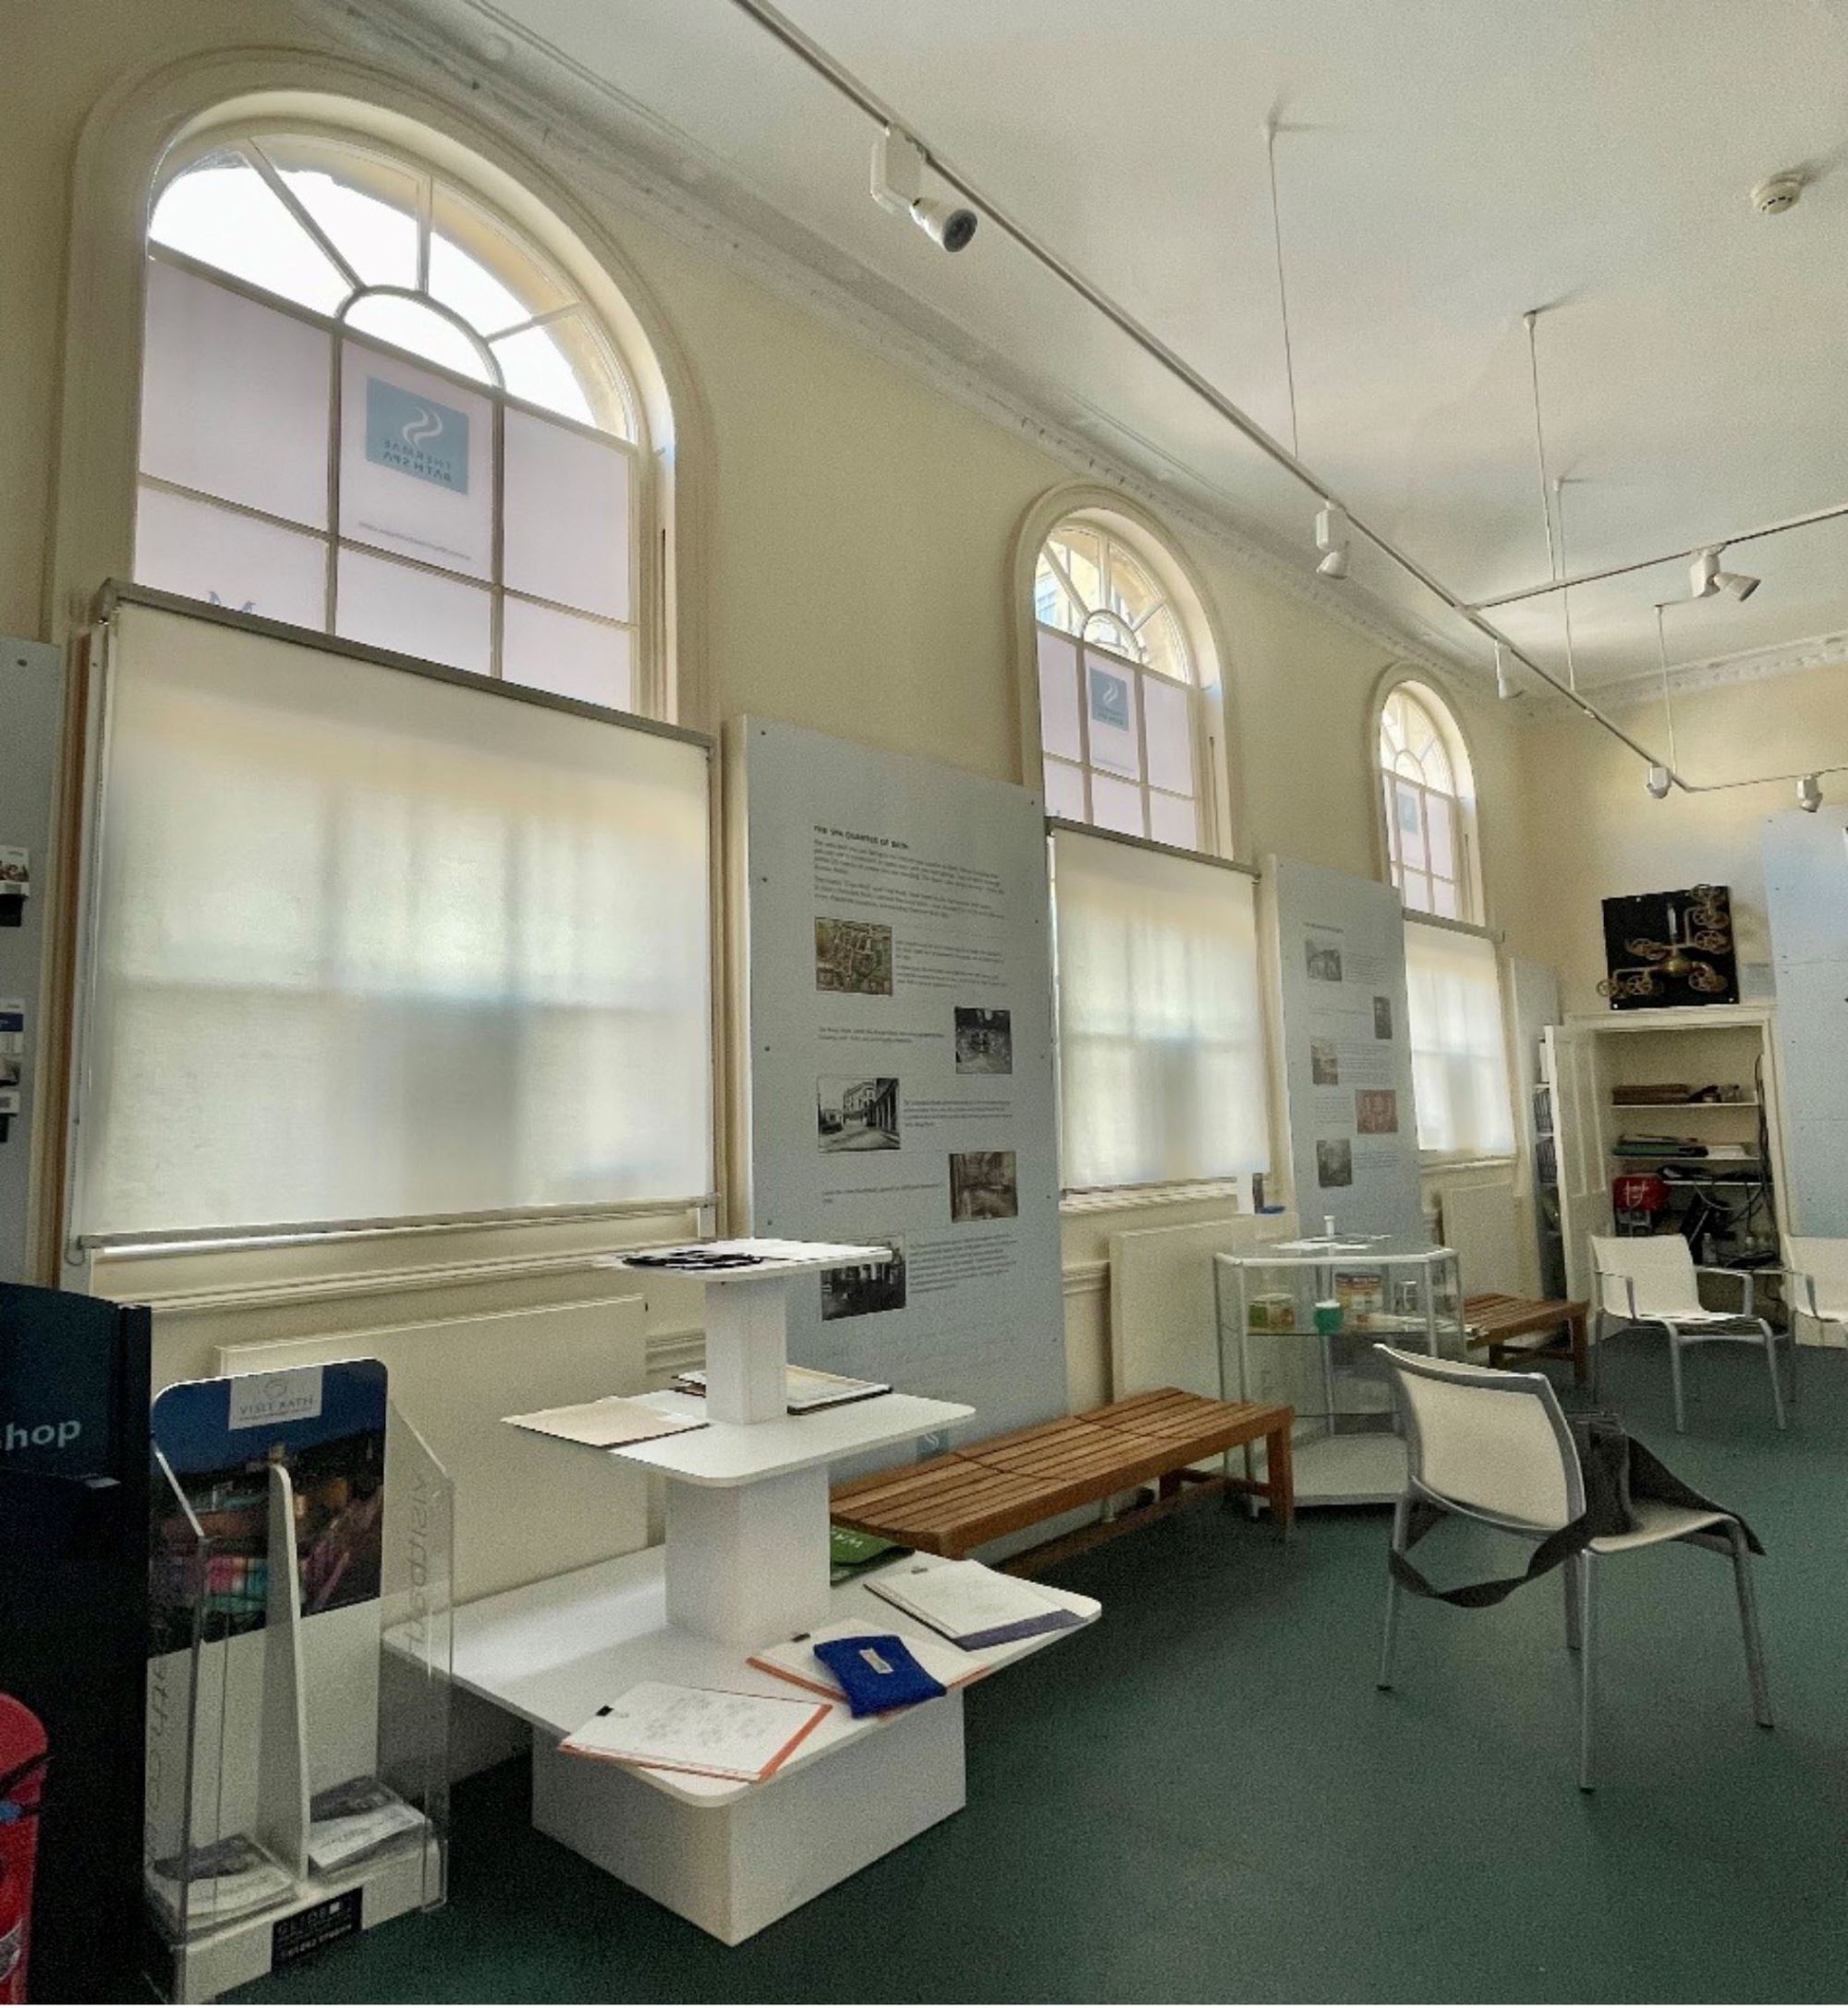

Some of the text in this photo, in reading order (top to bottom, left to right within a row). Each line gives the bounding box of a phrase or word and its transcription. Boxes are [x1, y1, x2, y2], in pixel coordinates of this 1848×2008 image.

[238, 1401, 273, 1415] VISIT
[279, 1394, 313, 1409] BATH
[0, 1419, 81, 1452] hop
